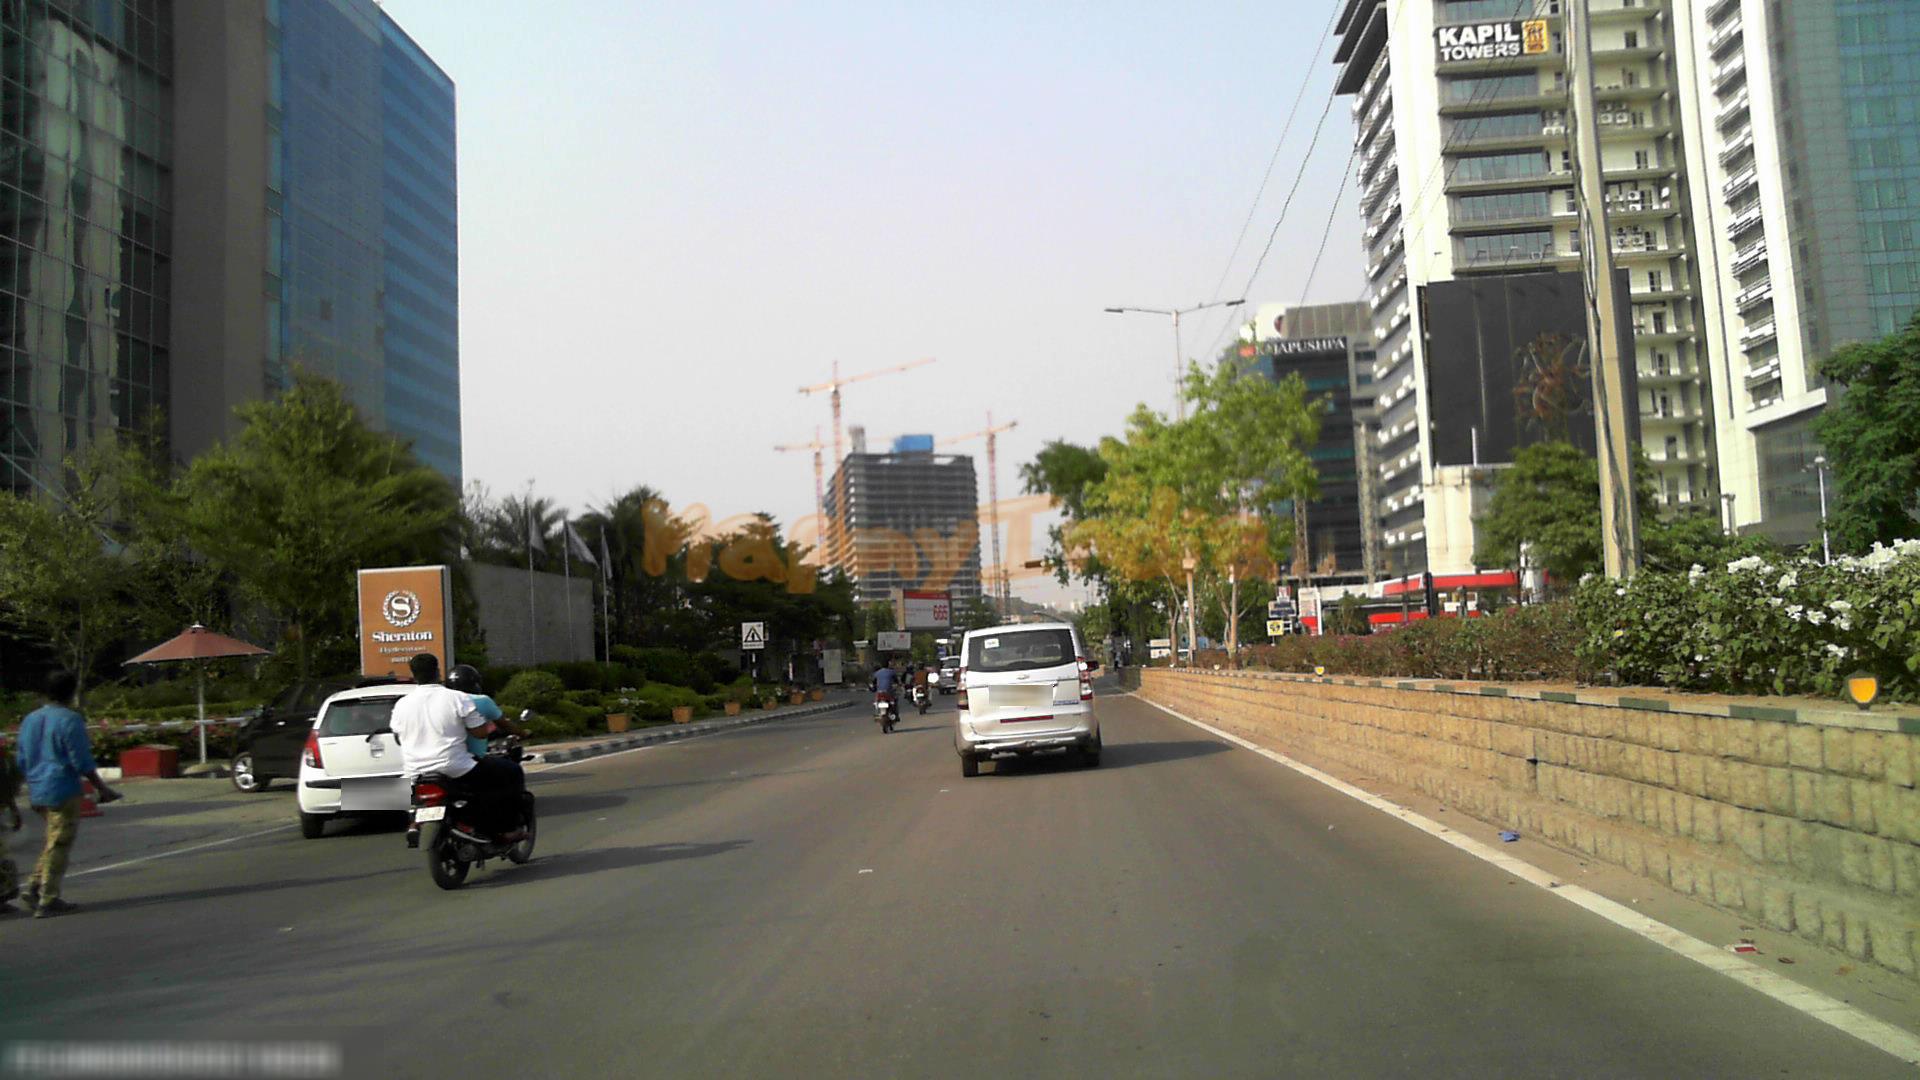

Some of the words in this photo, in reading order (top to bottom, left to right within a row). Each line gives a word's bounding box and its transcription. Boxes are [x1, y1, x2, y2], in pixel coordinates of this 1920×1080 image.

[1439, 23, 1520, 47] KAPIL
[1441, 42, 1520, 61] TOWERS
[372, 630, 433, 642] Sheraton
